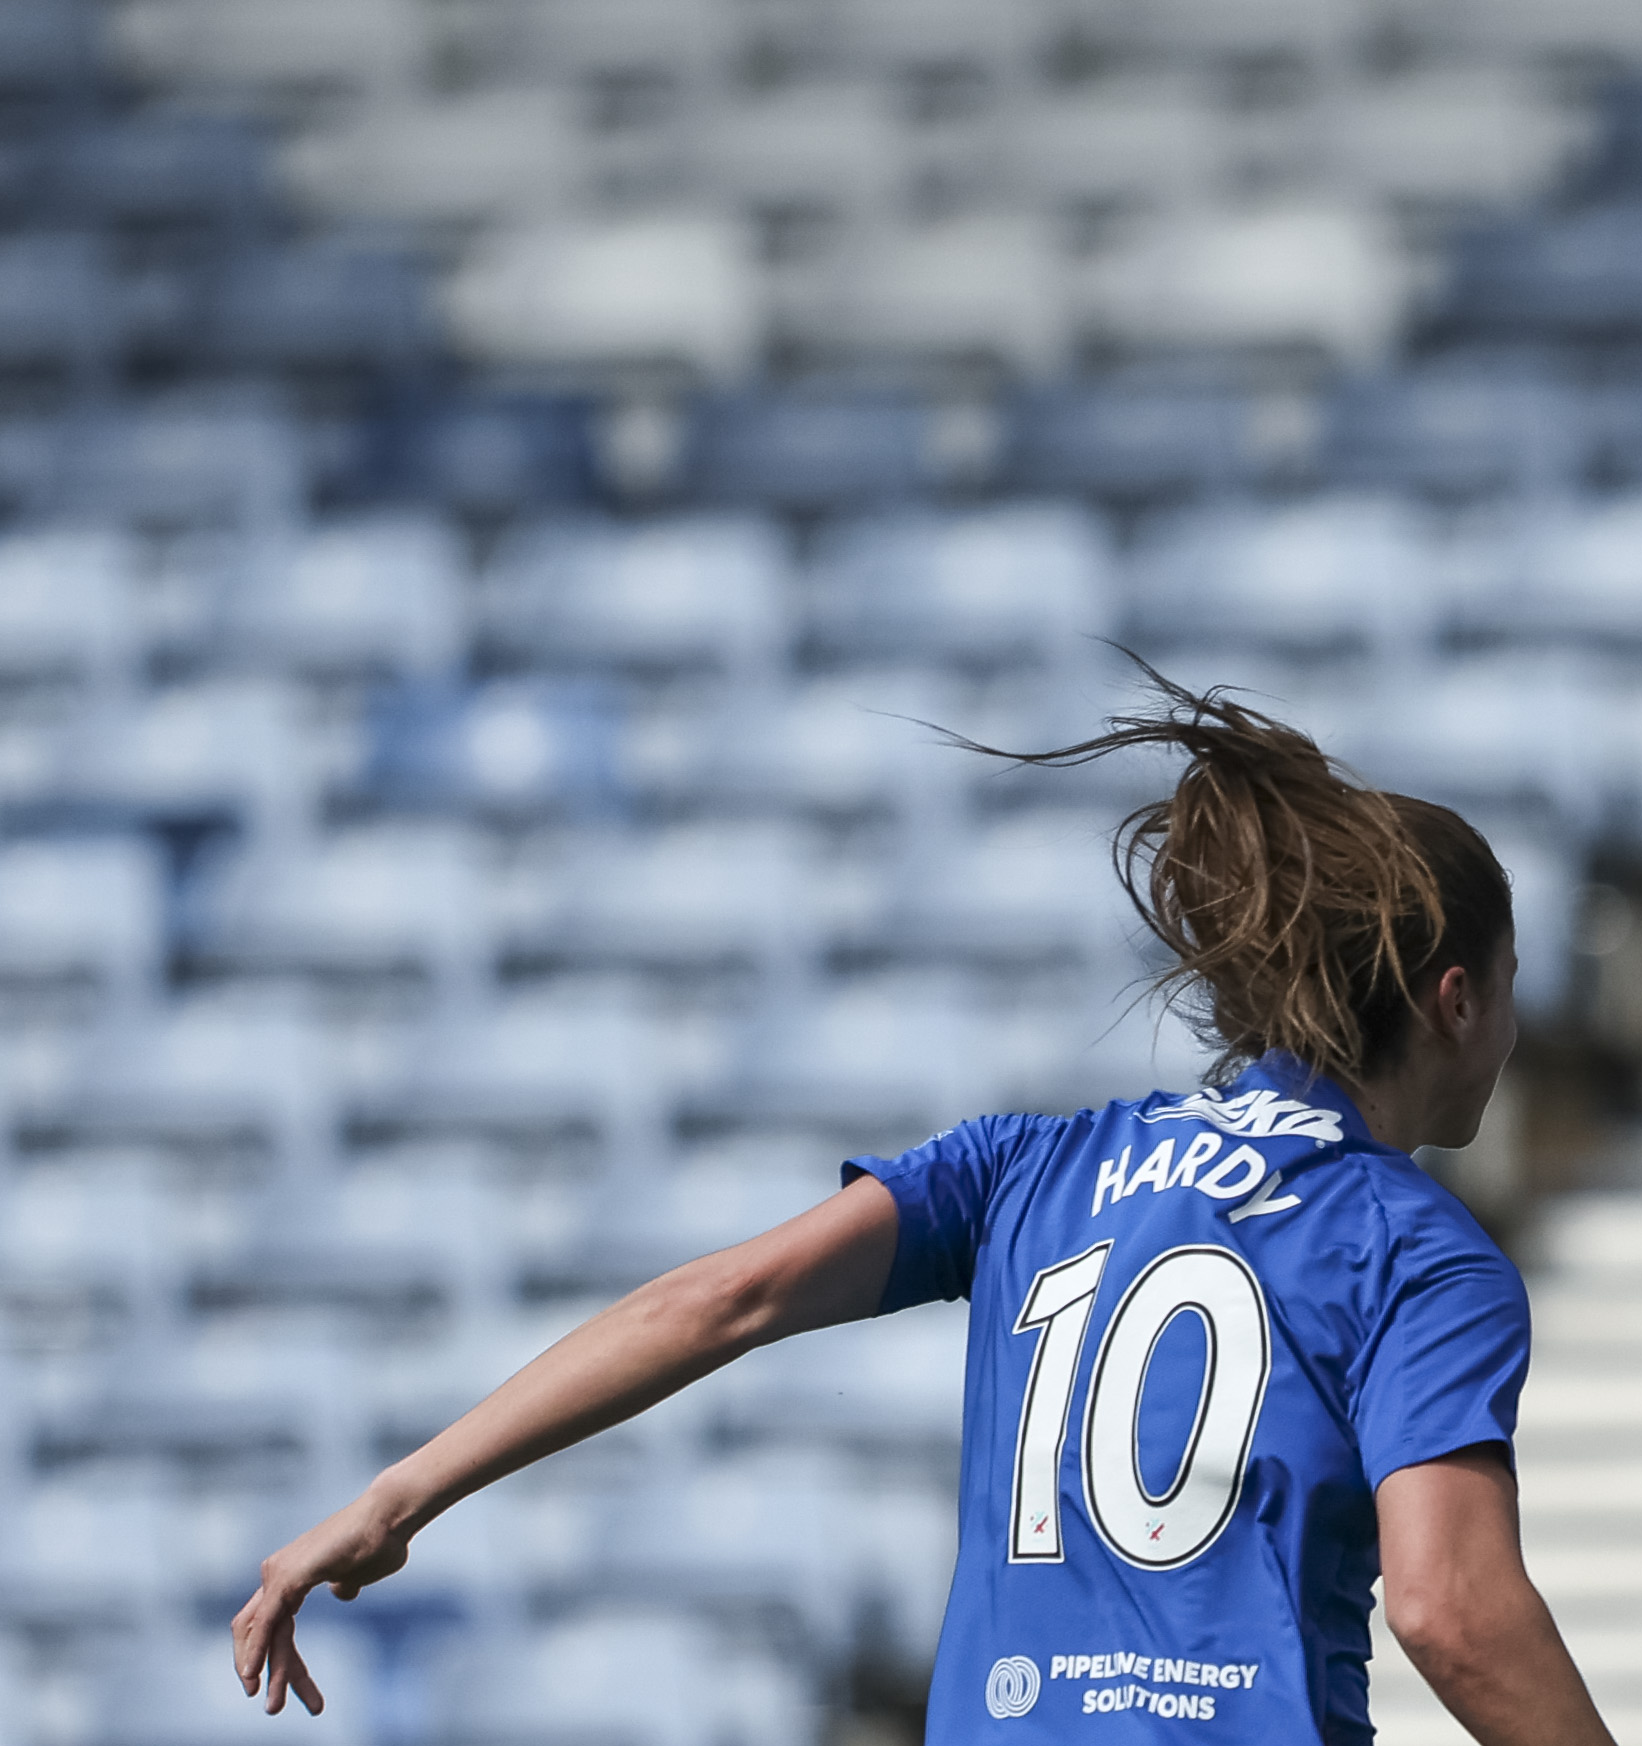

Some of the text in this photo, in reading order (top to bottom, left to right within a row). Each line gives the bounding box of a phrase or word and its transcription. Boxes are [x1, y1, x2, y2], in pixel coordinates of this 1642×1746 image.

[1165, 1087, 1344, 1142] EKO
[1090, 1131, 1303, 1225] HARDY
[1008, 1239, 1272, 1571] 10
[1153, 1658, 1259, 1690] ENERGY
[1082, 1684, 1216, 1721] SOLUTIONS
